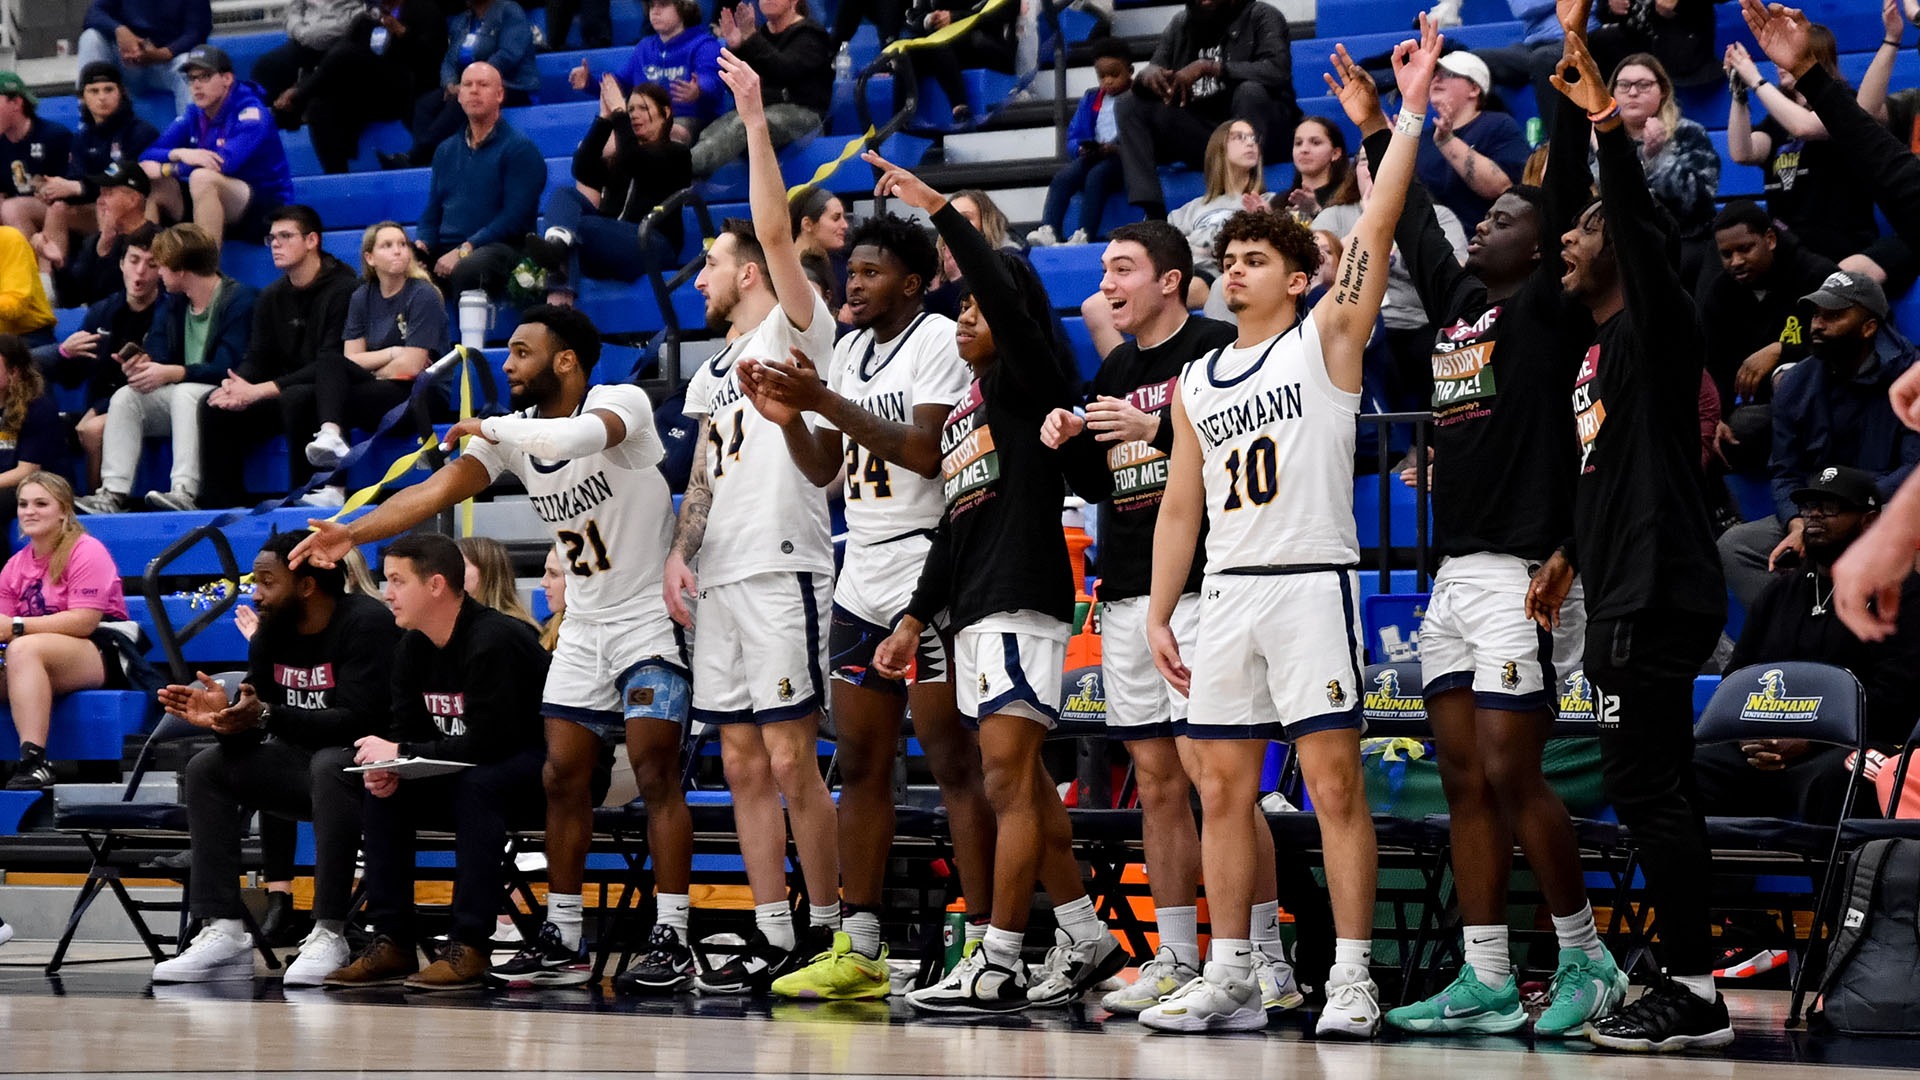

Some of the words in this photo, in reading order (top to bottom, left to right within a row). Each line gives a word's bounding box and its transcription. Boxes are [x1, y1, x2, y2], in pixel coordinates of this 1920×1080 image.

[1432, 346, 1485, 378] HISTORY
[1137, 383, 1169, 409] THE
[1196, 382, 1303, 453] NEUMANN
[1465, 409, 1492, 420] Union
[706, 408, 745, 480] 14
[1111, 439, 1157, 470] HISTO
[845, 438, 892, 501] 24
[961, 458, 990, 489] ME!
[1113, 466, 1138, 492] FOR
[1223, 434, 1279, 512] 10
[529, 471, 614, 522] EUMANN
[557, 519, 612, 578] 21
[281, 667, 308, 688] IT'S
[1065, 696, 1107, 712] NEUMA
[1743, 711, 1785, 719] UNIVERSITY
[1746, 695, 1819, 712] NEUMANN
